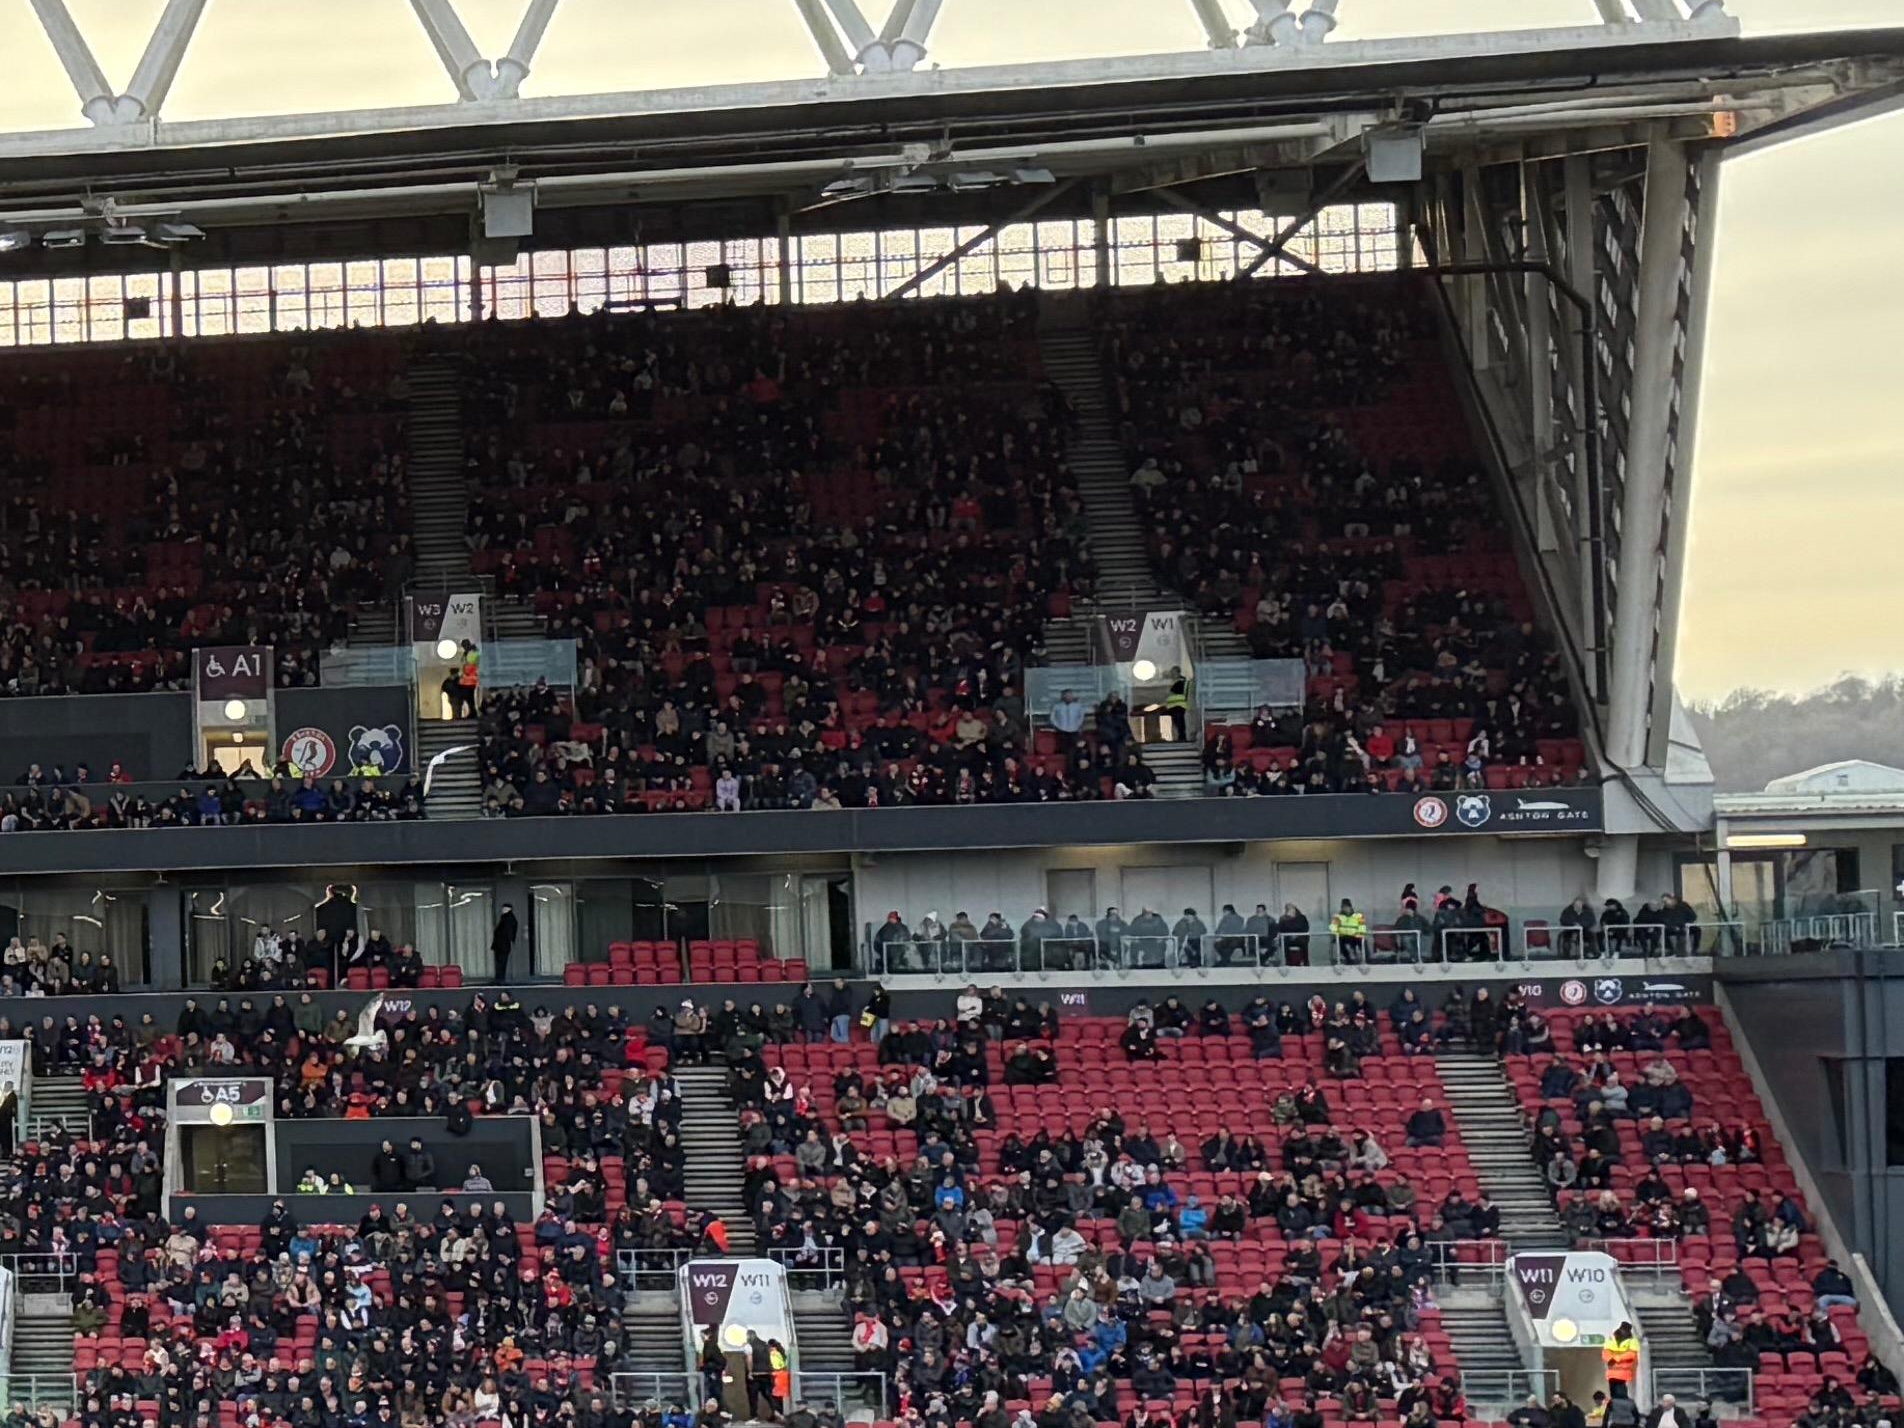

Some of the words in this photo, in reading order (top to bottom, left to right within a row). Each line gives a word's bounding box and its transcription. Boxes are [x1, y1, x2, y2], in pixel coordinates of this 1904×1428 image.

[419, 604, 440, 616] W3
[450, 603, 474, 614] W2
[1110, 618, 1137, 632] W2
[1151, 617, 1174, 630] W1
[232, 653, 261, 677] A1
[1500, 811, 1550, 821] ASHTON
[1557, 811, 1589, 821] GATE
[215, 1085, 241, 1102] A5
[693, 1274, 727, 1288] W12
[741, 1274, 770, 1287] W11
[1519, 1268, 1553, 1283] W11
[1567, 1267, 1605, 1283] W10
